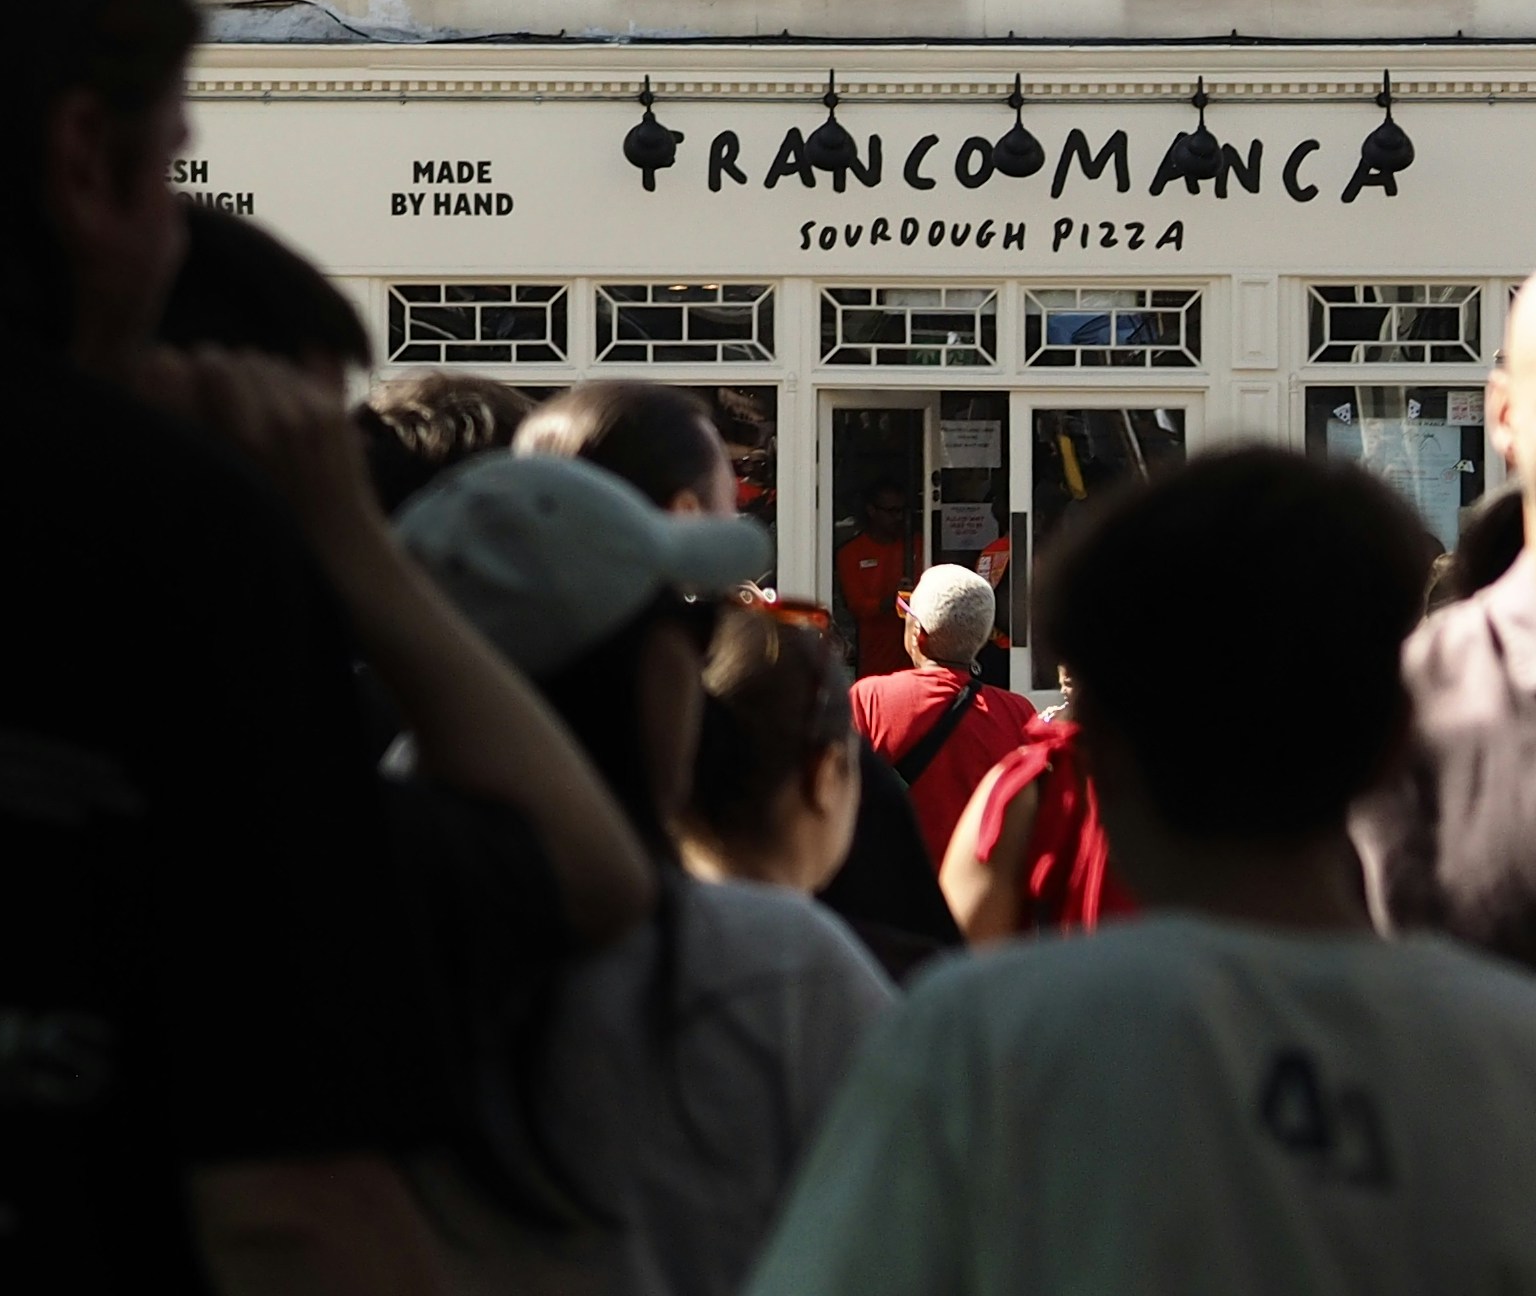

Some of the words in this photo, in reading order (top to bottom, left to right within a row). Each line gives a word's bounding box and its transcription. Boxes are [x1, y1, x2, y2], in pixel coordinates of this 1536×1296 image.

[412, 161, 493, 184] MADE
[1051, 128, 1398, 203] MANCA
[391, 193, 426, 217] BY
[432, 193, 515, 217] HAND
[800, 216, 1026, 252] SOURDOUGH
[1052, 217, 1185, 253] PIZZA
